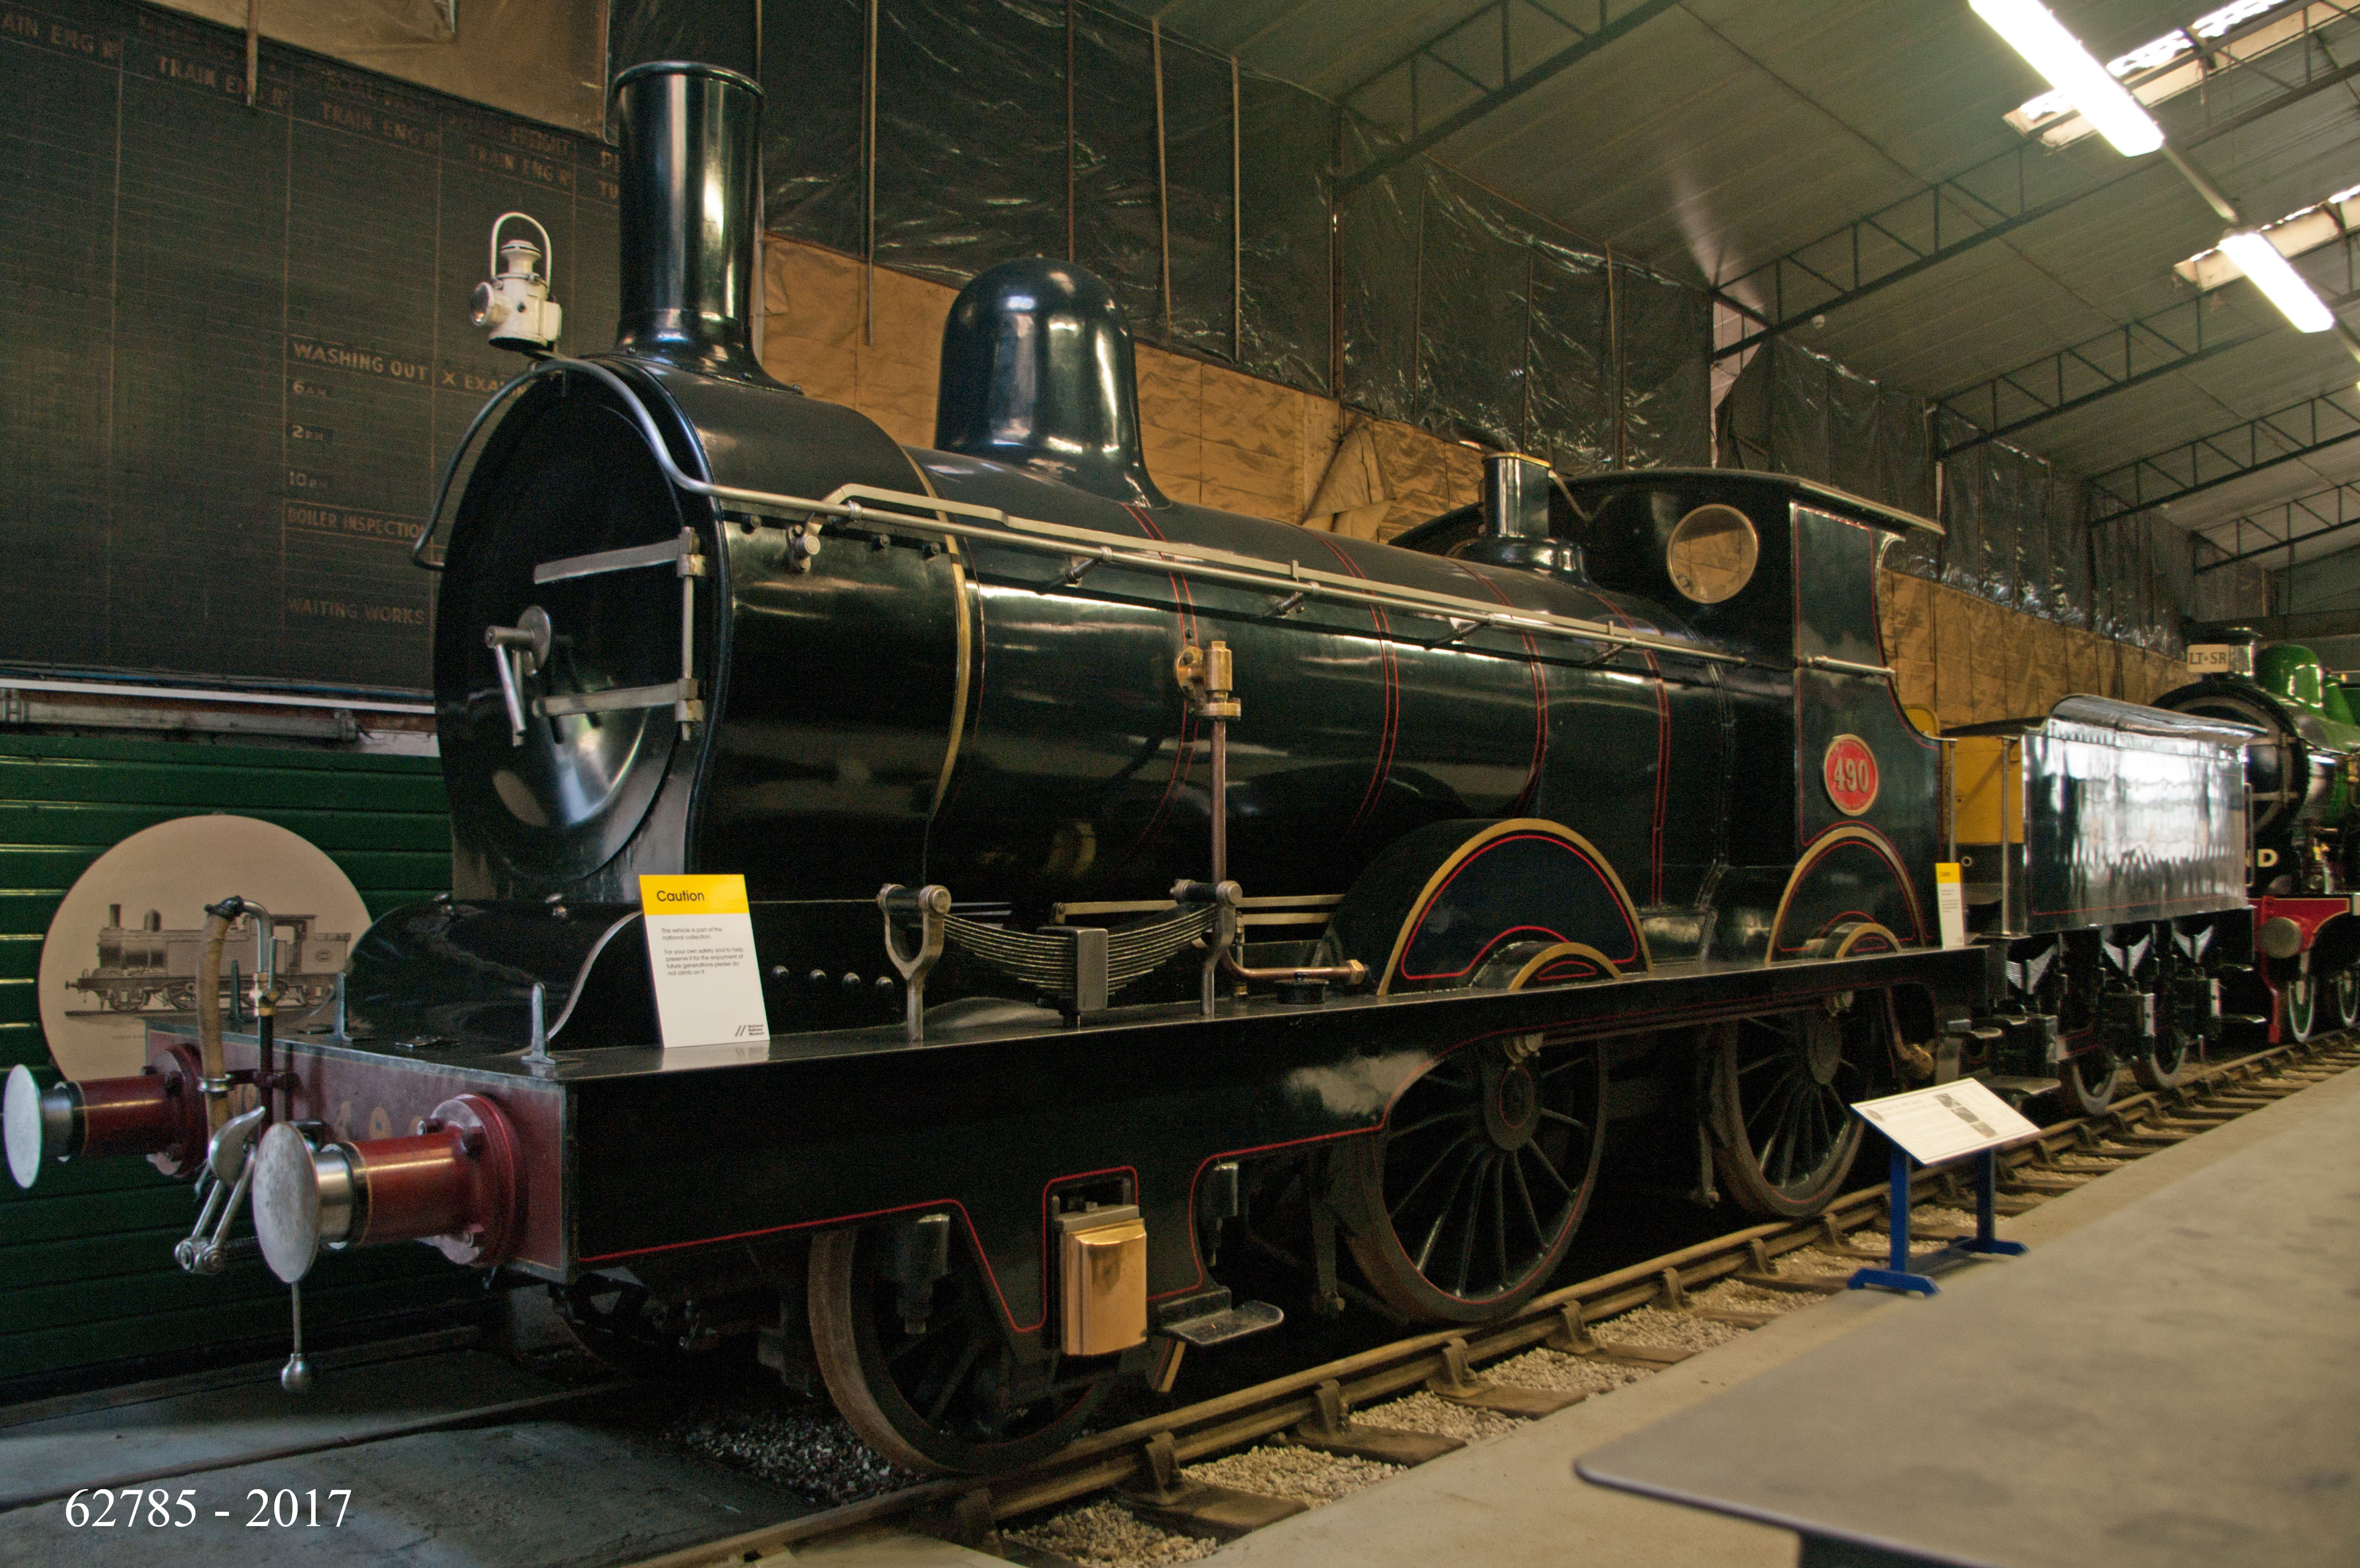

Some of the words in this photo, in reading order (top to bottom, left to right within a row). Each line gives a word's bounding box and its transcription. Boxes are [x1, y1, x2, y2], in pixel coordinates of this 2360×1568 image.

[292, 342, 384, 373] WASHING
[390, 360, 428, 381] OUT
[287, 507, 337, 529] BOILER
[287, 598, 358, 619] WAITING
[364, 604, 425, 625] WORKS
[1834, 757, 1869, 793] 490
[657, 890, 705, 901] Caution
